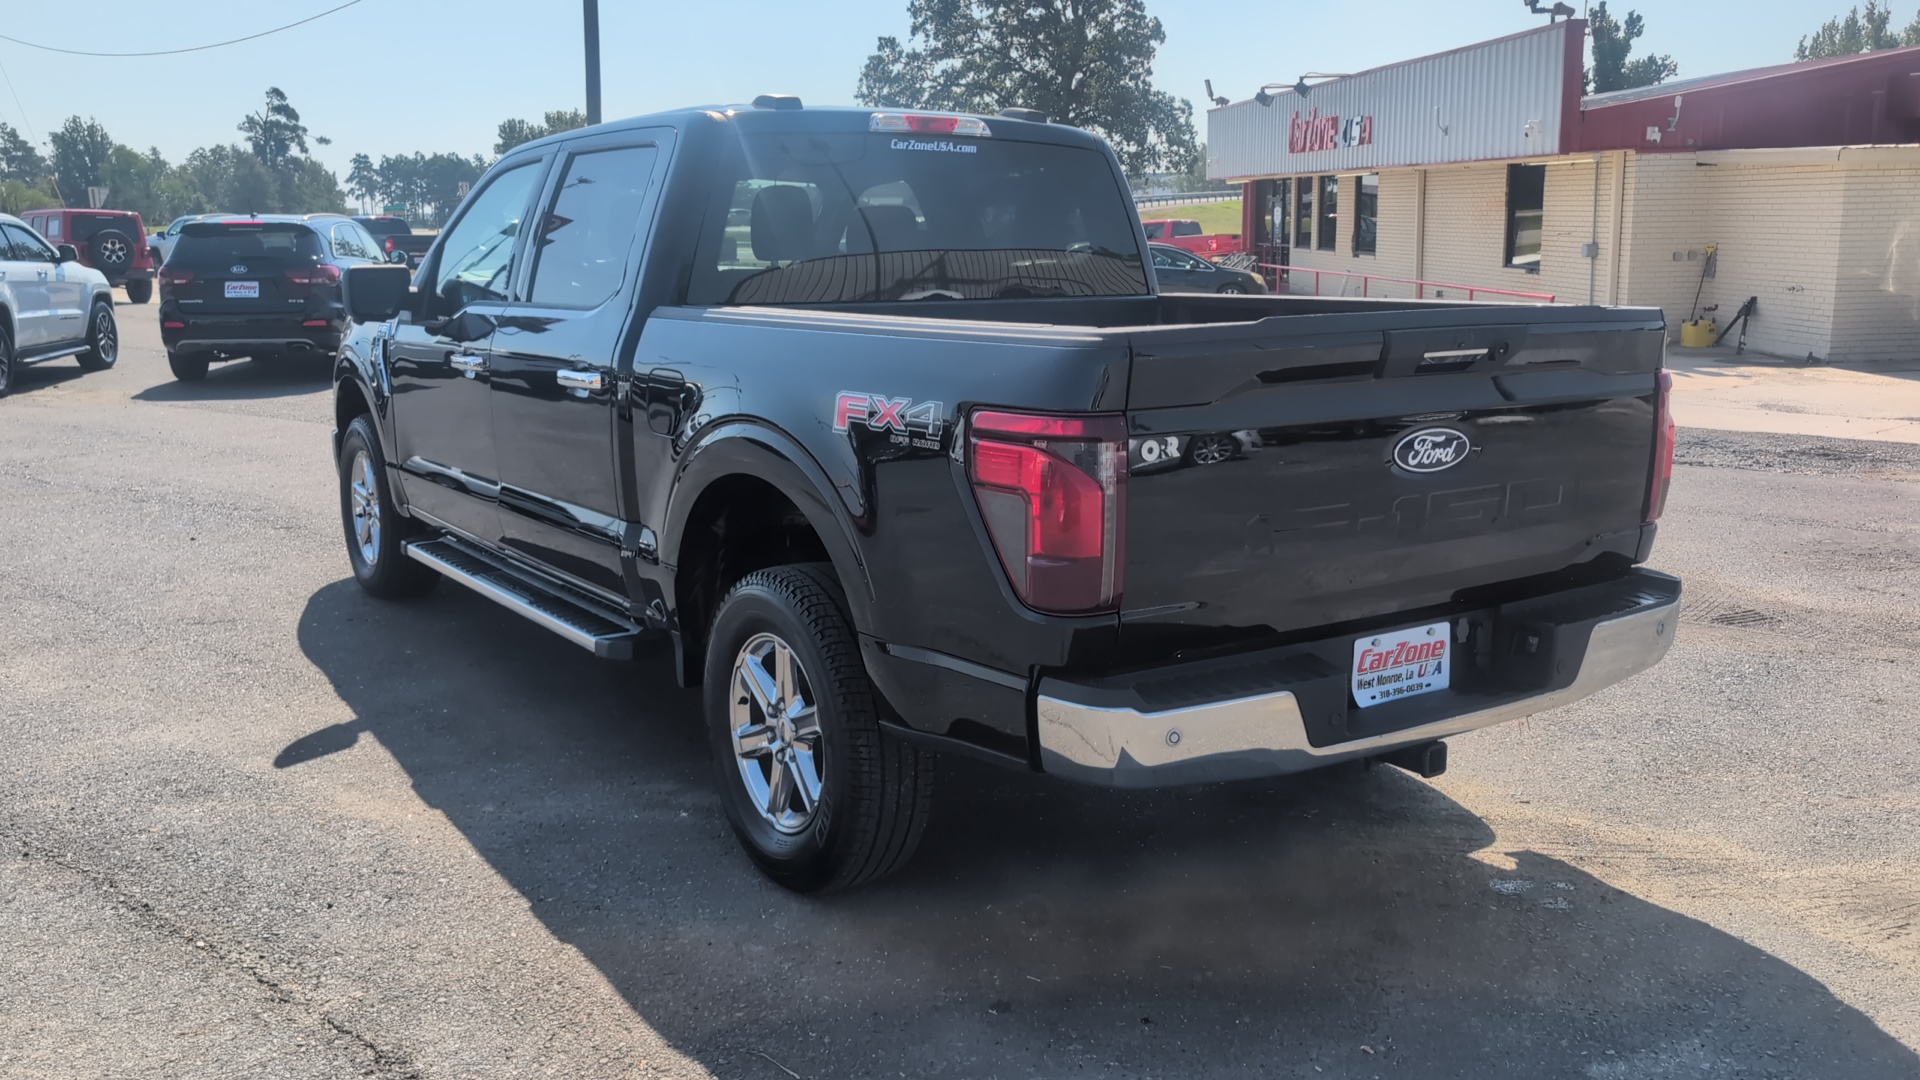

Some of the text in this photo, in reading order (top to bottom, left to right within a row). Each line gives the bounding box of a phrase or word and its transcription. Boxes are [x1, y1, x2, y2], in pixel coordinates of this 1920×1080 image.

[1342, 115, 1372, 148] USA
[891, 139, 977, 153] CarZoneUSA.com
[832, 390, 943, 440] FX4
[890, 435, 940, 450] OFF ROAD
[1408, 435, 1457, 466] Ford
[1357, 639, 1446, 675] CarZone
[1357, 669, 1414, 691] West Monroe, La
[1418, 661, 1442, 678] USA
[1379, 682, 1424, 699] 318-396-0039
